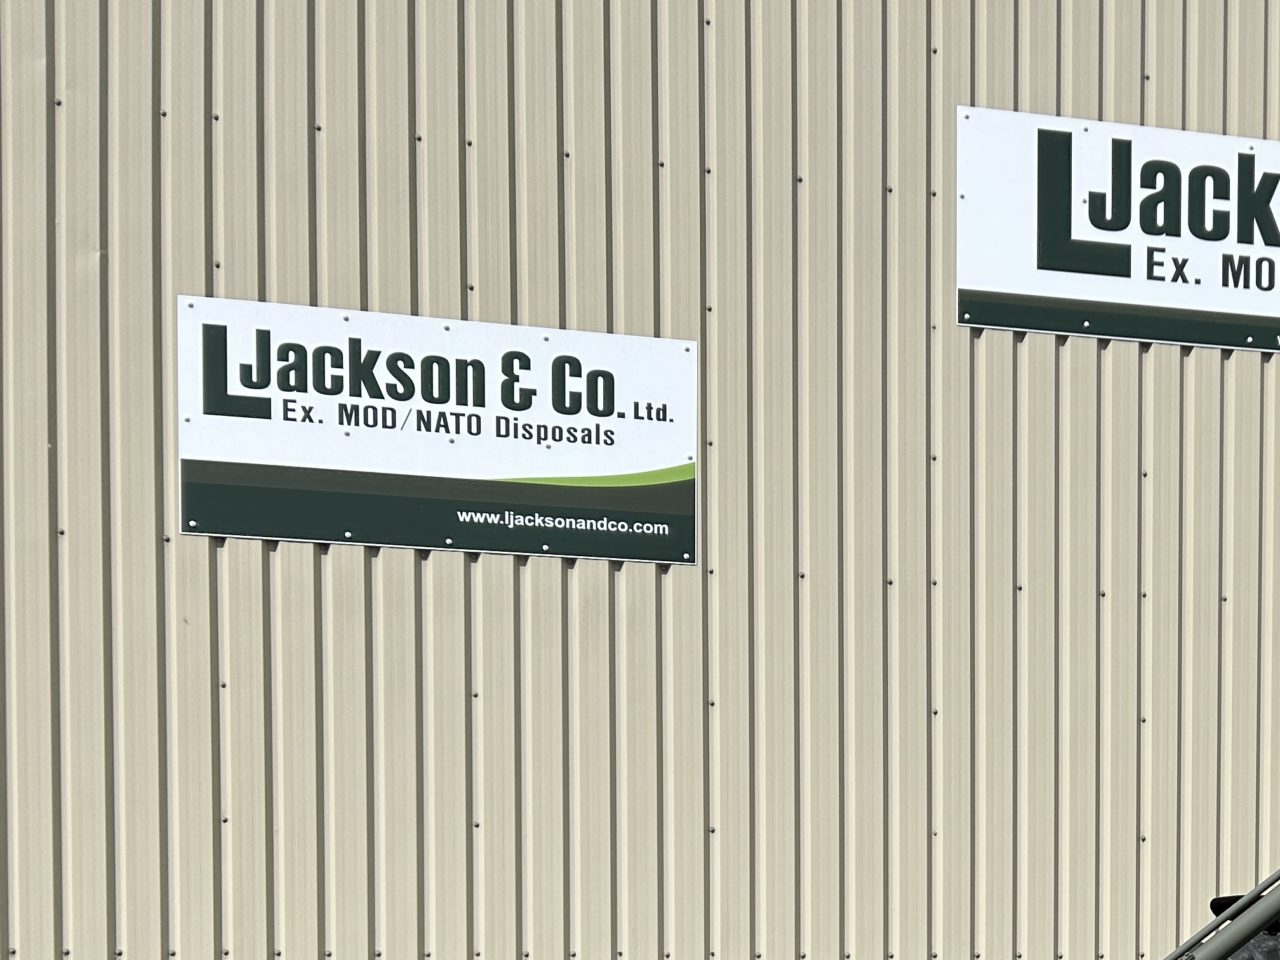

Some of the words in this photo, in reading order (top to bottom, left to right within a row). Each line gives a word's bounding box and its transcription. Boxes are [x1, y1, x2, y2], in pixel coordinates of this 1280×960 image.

[1146, 246, 1201, 285] Ex.
[500, 351, 537, 412] &
[551, 356, 626, 419] Co.
[633, 401, 674, 423] Ltd.
[282, 398, 324, 424] Ex.
[338, 404, 482, 437] MOD/NATO
[495, 415, 615, 446] Disposals
[456, 510, 669, 535] www.ljacksonandco.com
